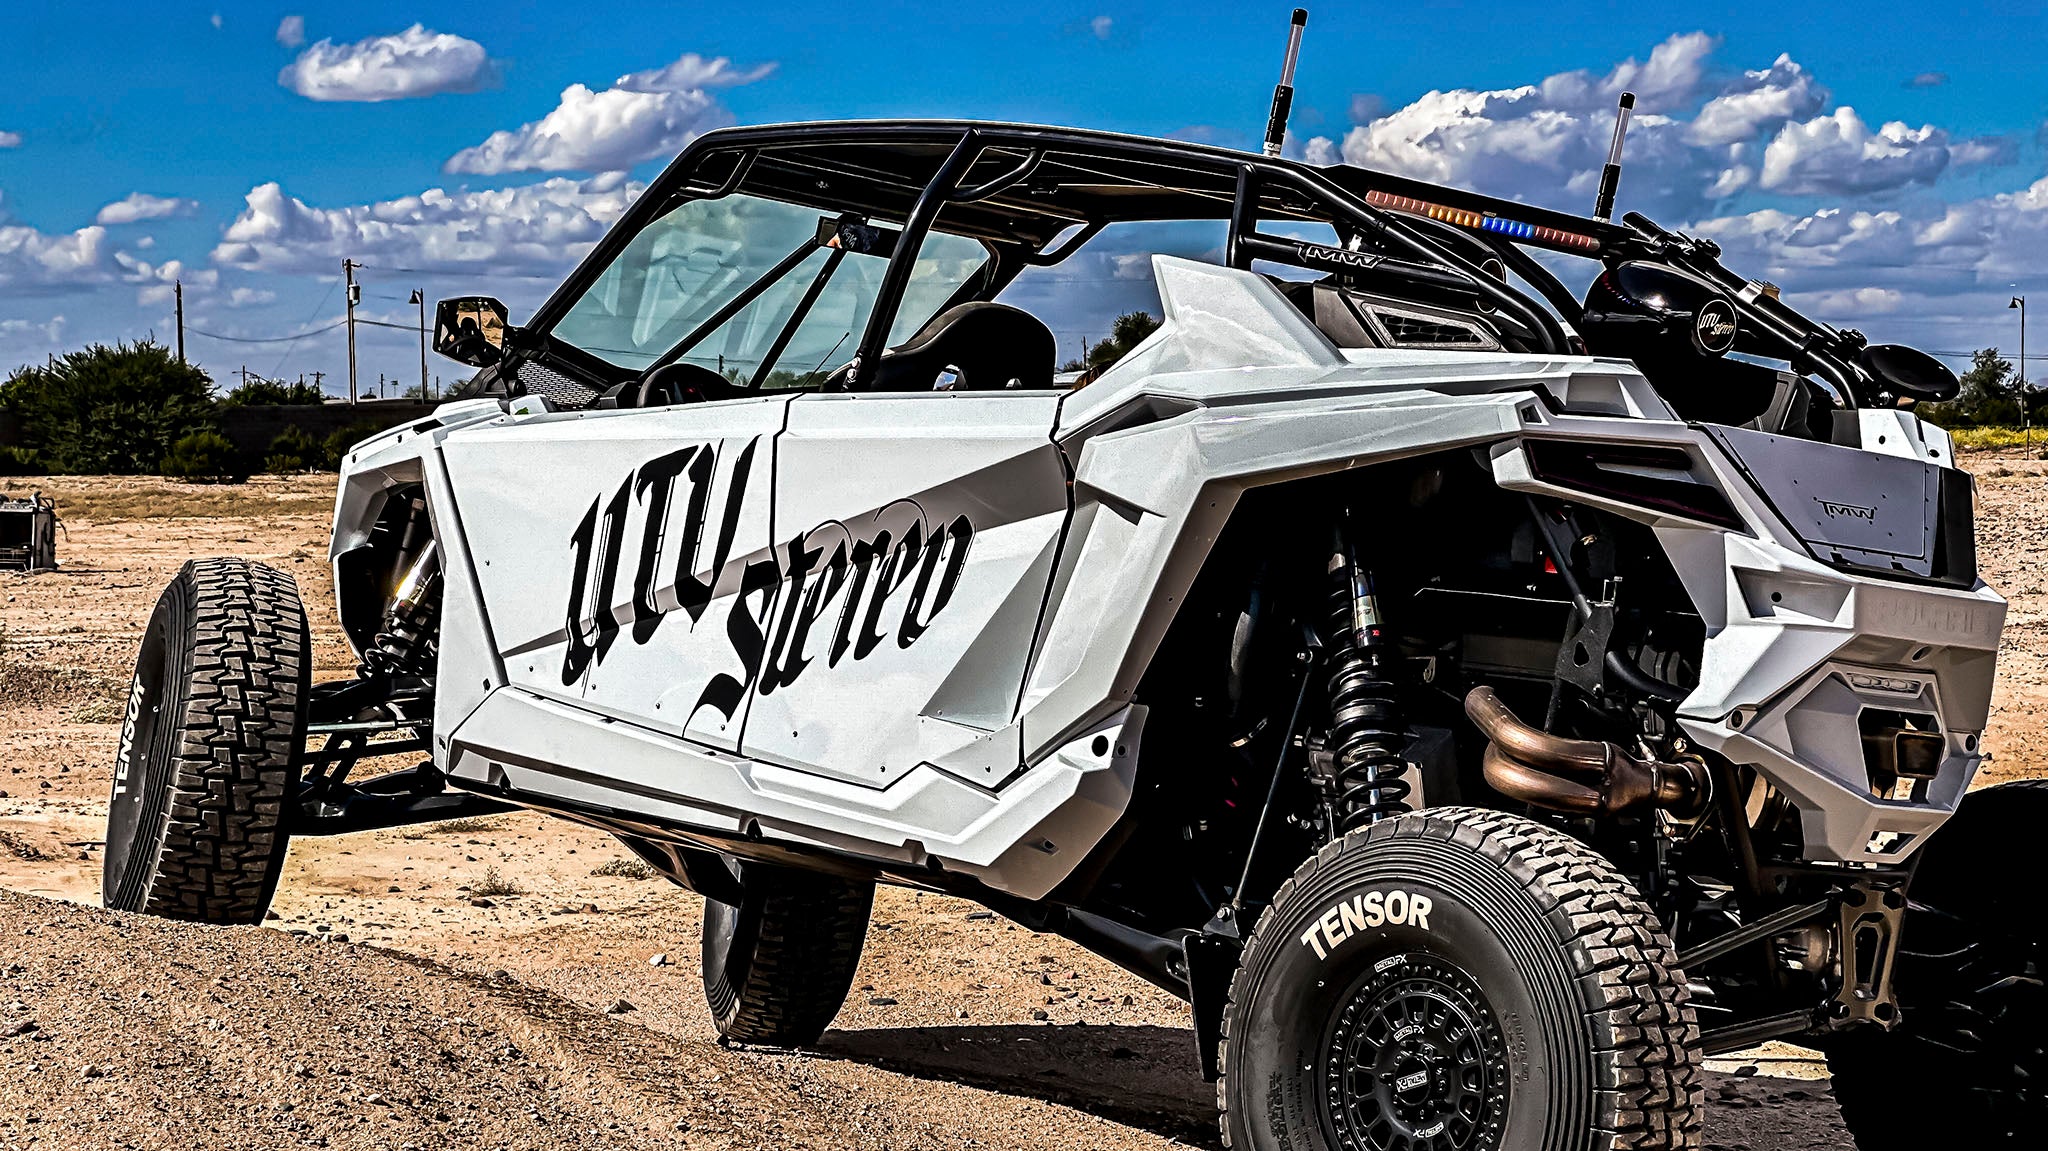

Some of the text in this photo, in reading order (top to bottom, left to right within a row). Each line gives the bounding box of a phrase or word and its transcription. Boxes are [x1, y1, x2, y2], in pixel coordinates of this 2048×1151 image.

[1293, 242, 1387, 269] TMW
[1700, 312, 1721, 330] UTV
[1817, 500, 1877, 521] TMW
[562, 434, 763, 698] UTV
[682, 498, 977, 738] Stereo
[113, 673, 146, 800] TENSOR
[1301, 890, 1433, 961] TENSOR
